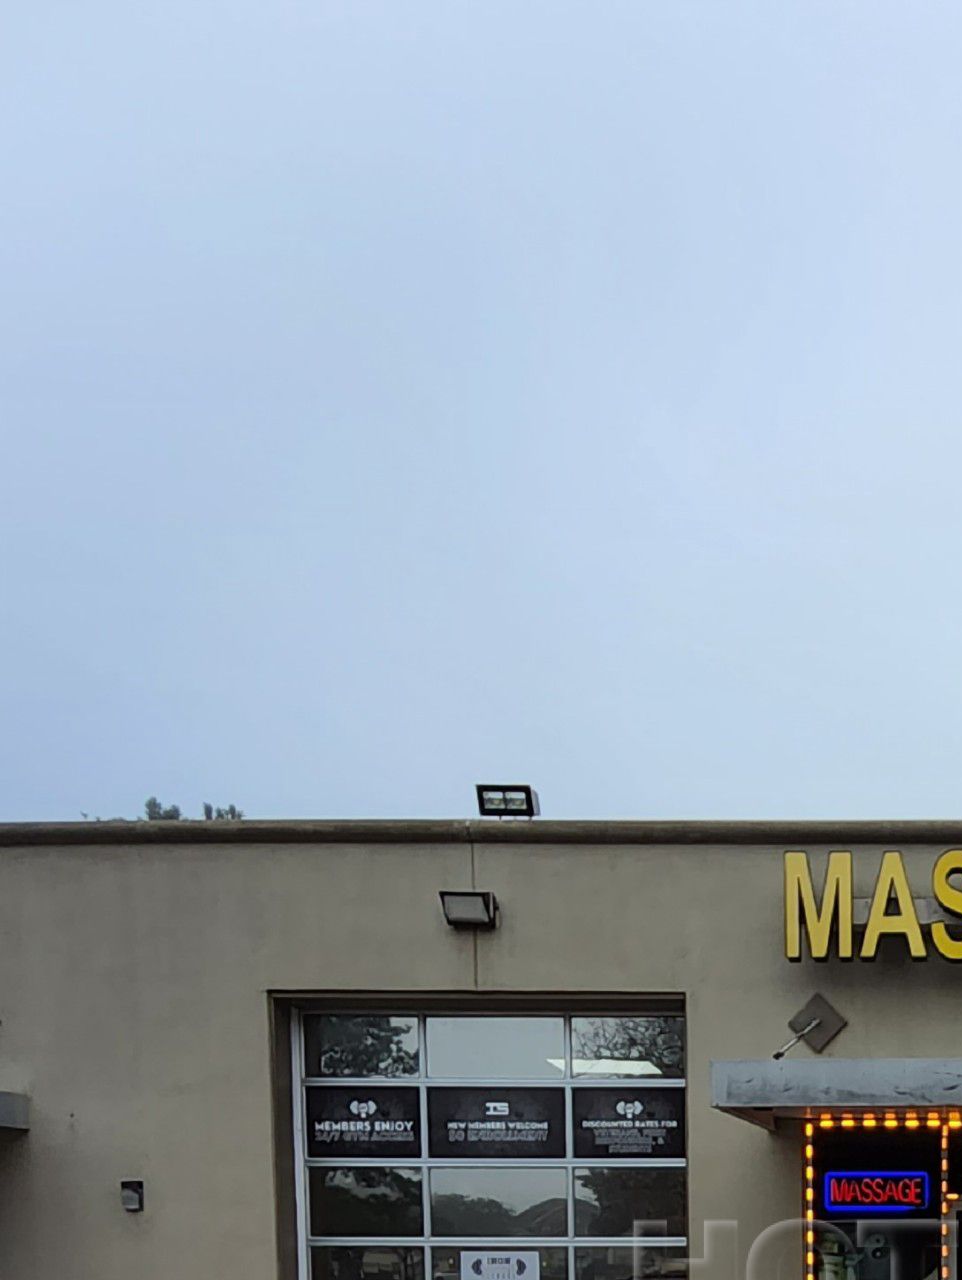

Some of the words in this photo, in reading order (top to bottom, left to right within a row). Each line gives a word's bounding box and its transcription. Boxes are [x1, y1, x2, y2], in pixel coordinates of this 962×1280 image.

[315, 1120, 371, 1131] MEMBERS
[374, 1120, 414, 1131] ENJOY
[447, 1121, 466, 1129] NEW
[507, 1121, 548, 1129] WELCOME
[830, 1178, 921, 1203] MASSAGE
